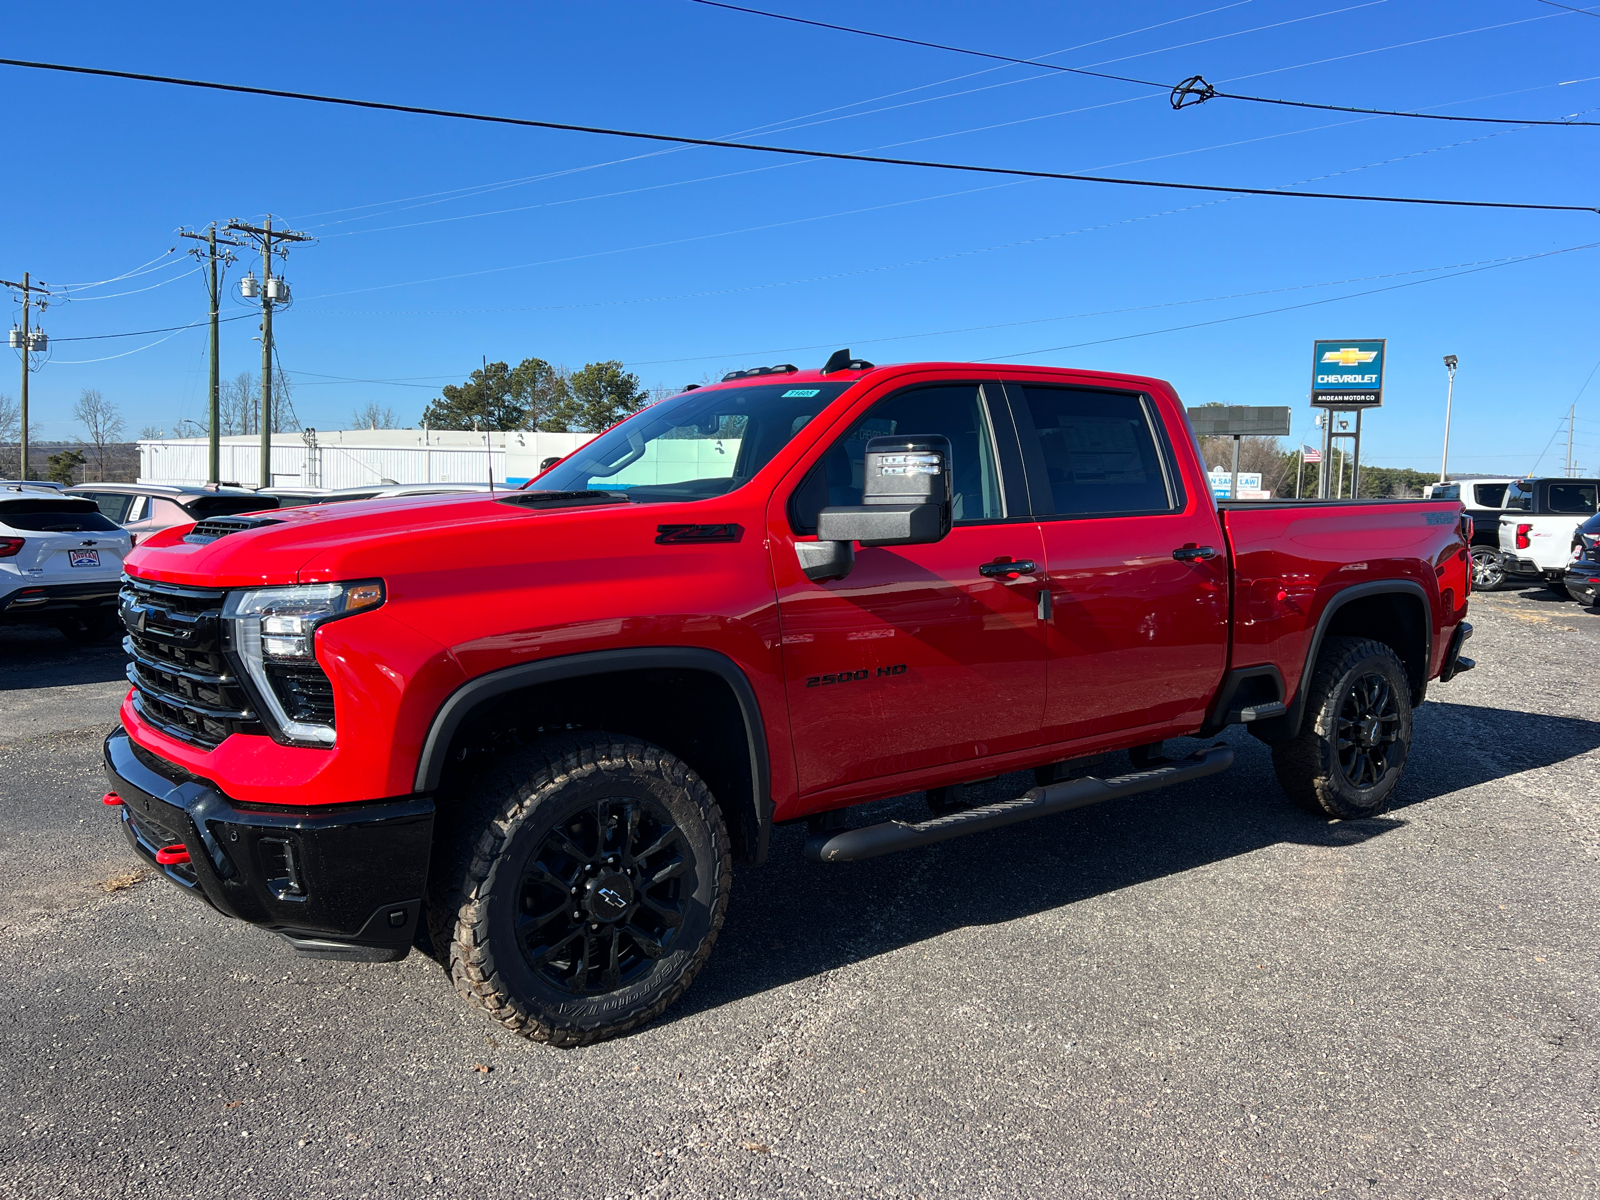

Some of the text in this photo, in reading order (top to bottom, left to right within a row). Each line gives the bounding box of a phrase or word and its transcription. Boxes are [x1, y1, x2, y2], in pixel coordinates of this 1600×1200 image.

[1317, 374, 1378, 384] CHEVROLET
[654, 523, 739, 544] Z71
[72, 552, 98, 562] ANDEAN
[805, 664, 907, 688] 2500 HD
[558, 949, 690, 1017] Terrain T/A
